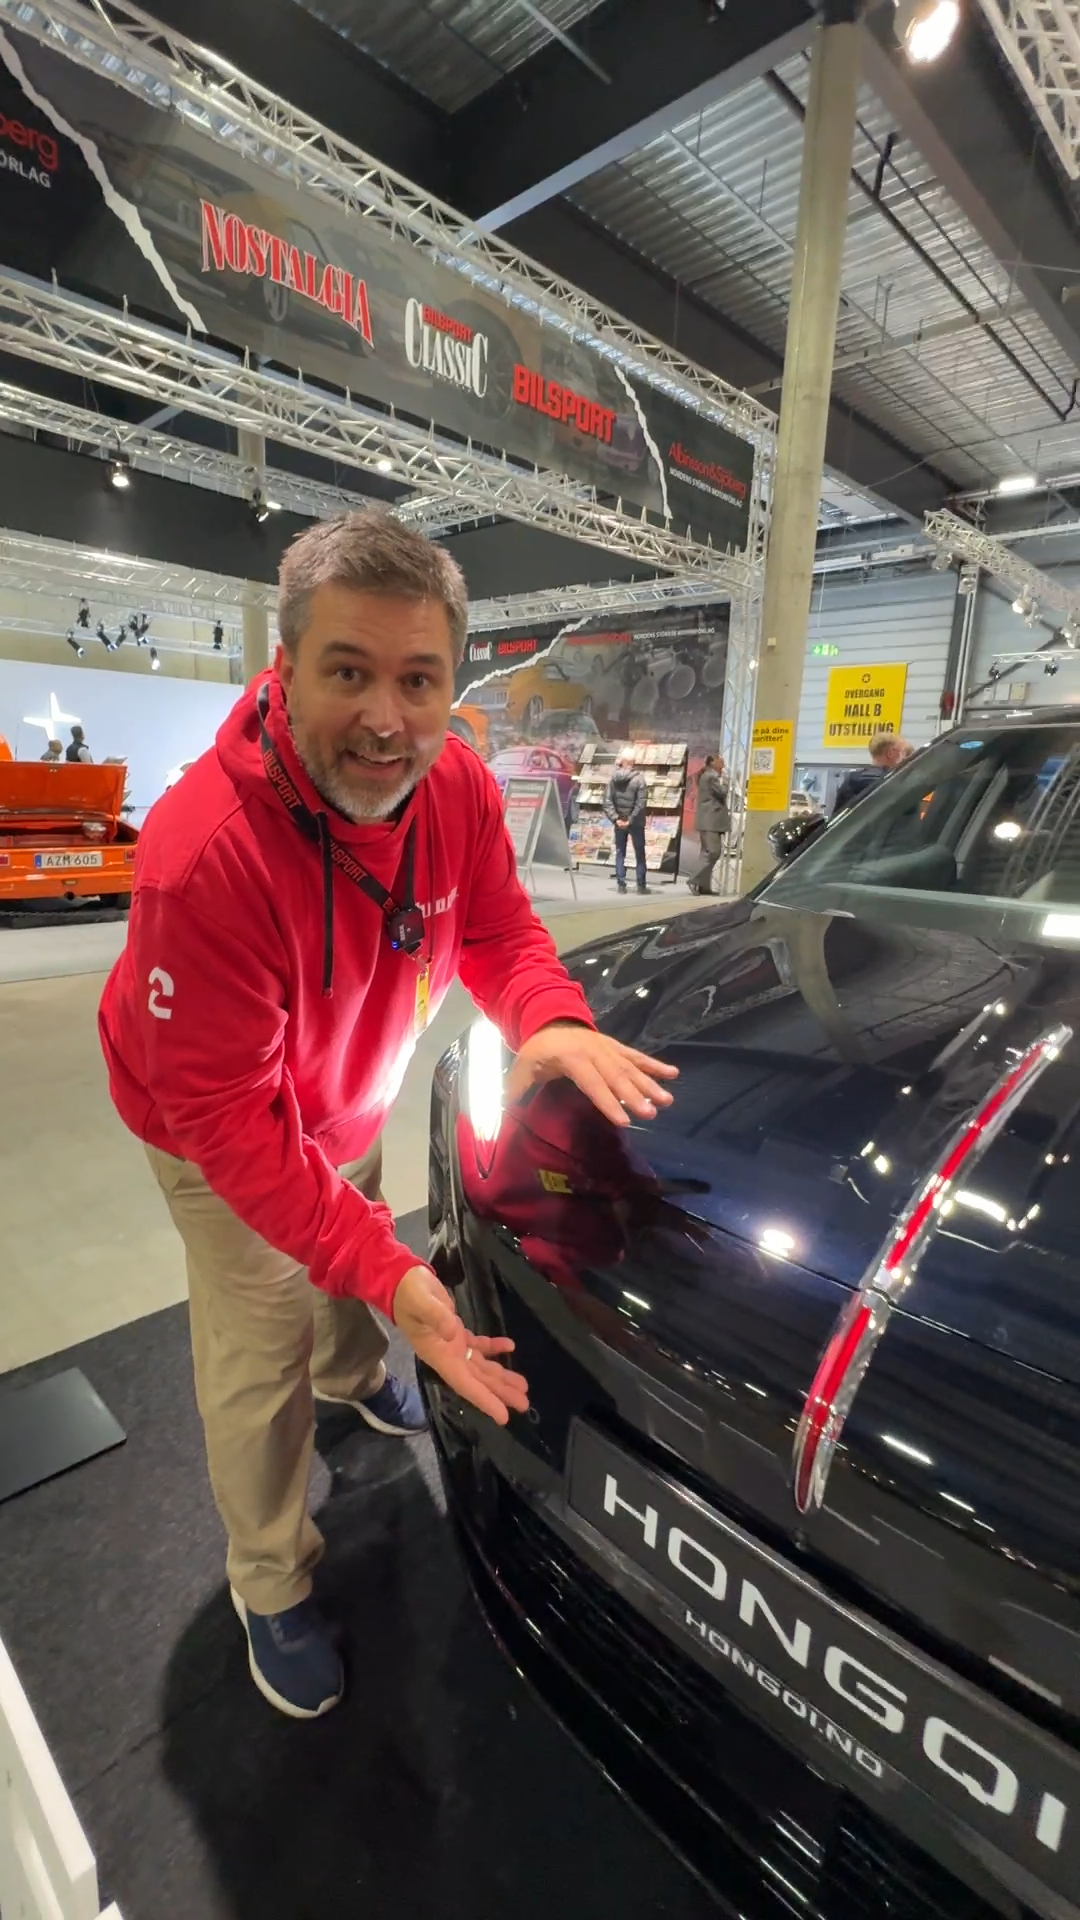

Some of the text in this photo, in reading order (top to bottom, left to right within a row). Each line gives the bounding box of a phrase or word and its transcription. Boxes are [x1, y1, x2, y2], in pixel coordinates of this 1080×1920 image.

[200, 198, 374, 348] NOSTALGIA
[422, 304, 474, 343] BILSPORT
[512, 363, 616, 444] BILSPORT
[844, 688, 885, 699] OVERGANG
[844, 703, 882, 718] HALL B
[771, 726, 789, 735] dine
[263, 748, 302, 809] BILSPORT
[74, 853, 98, 866] 605
[329, 838, 369, 883] ILSPORT
[602, 1473, 1067, 1852] HONGQI
[685, 1609, 884, 1778] HONGQI.NO
